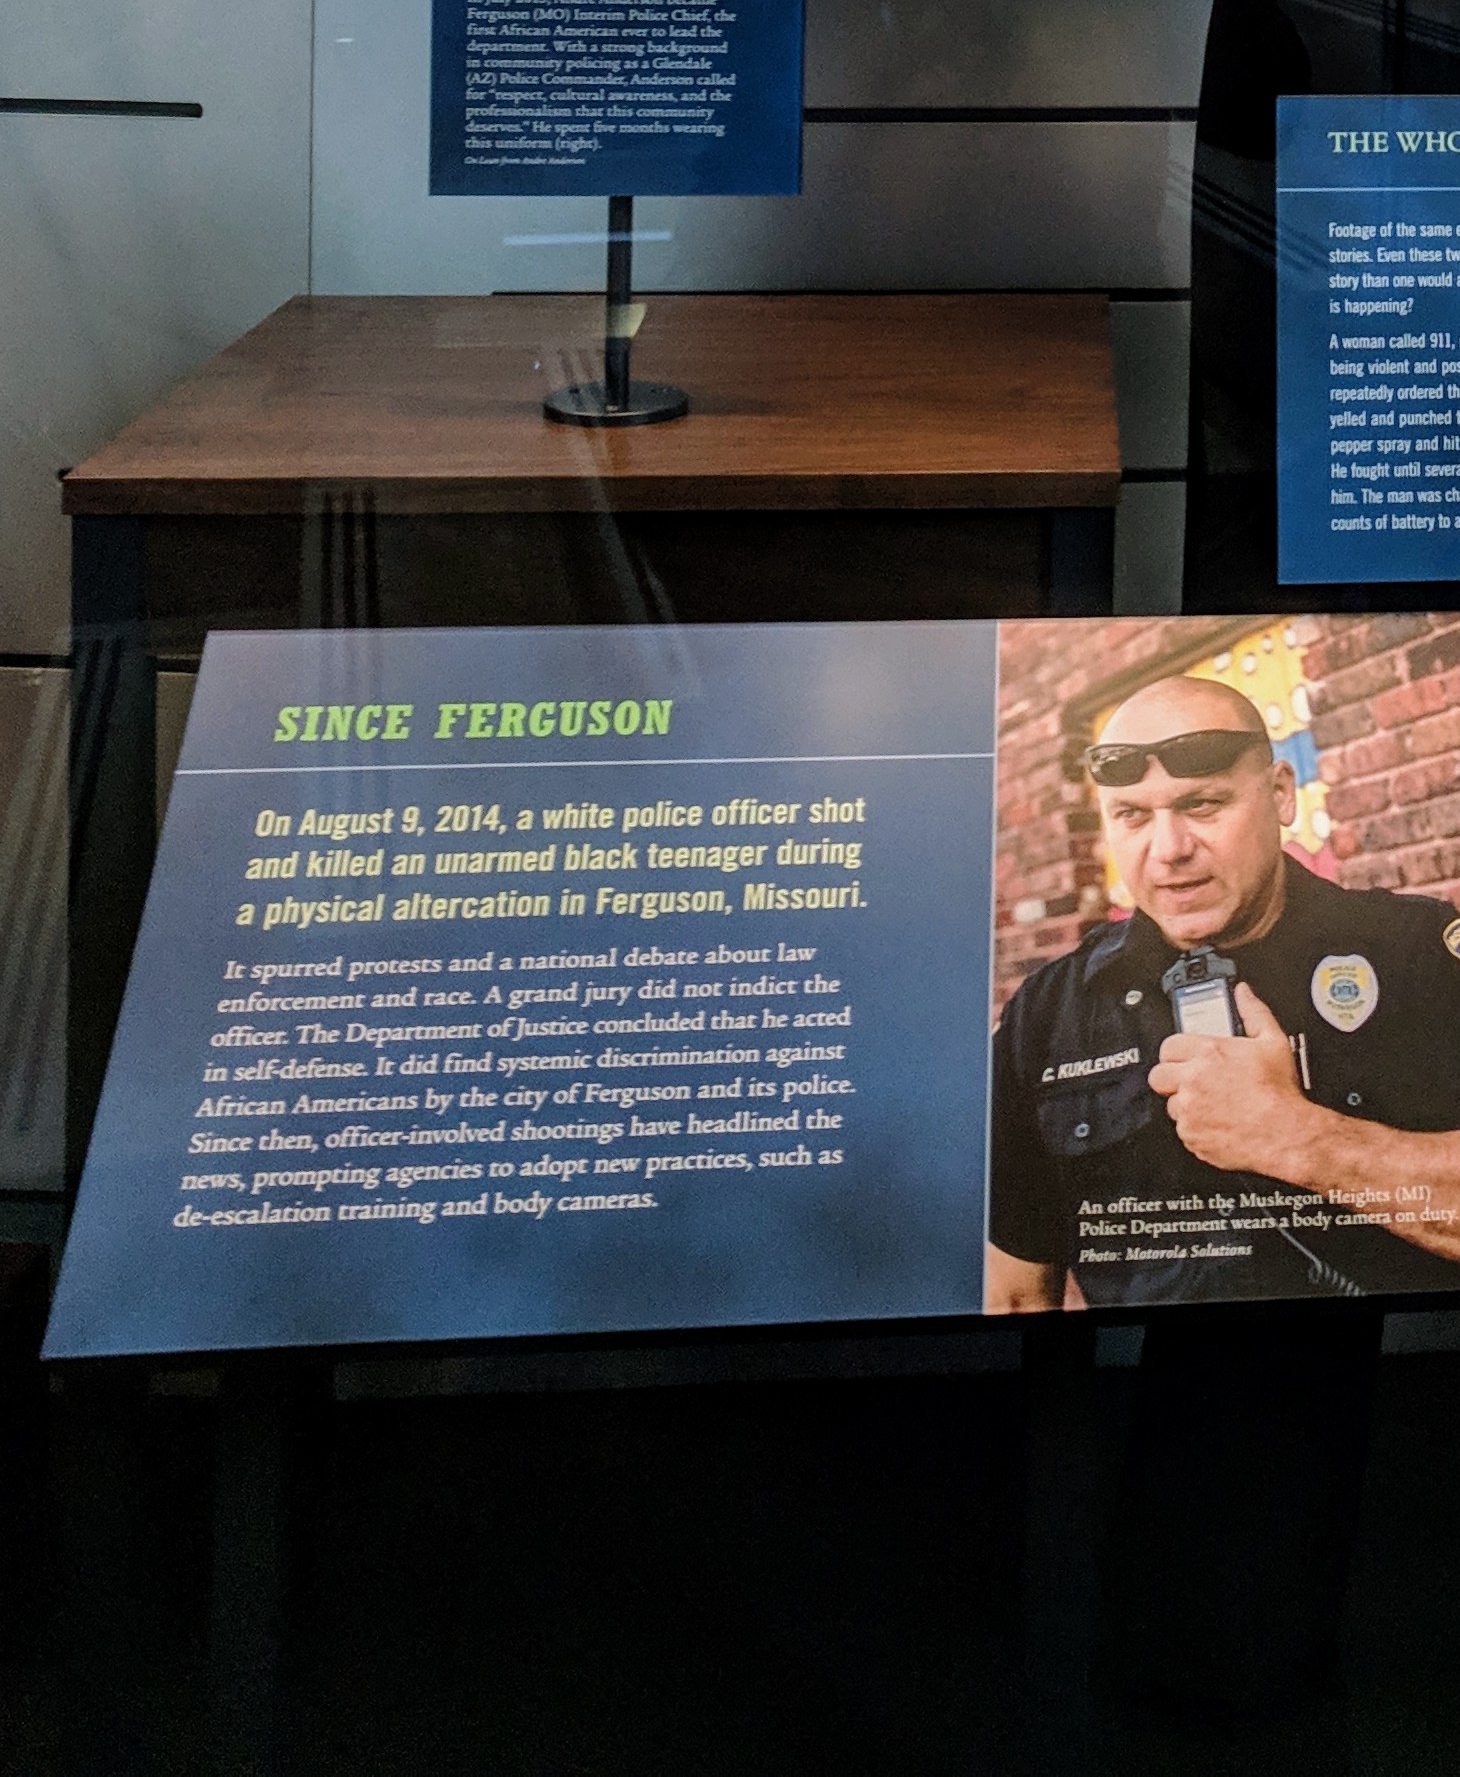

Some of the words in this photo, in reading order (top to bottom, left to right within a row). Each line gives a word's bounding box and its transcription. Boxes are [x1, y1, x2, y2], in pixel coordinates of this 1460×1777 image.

[1327, 131, 1389, 153] THE
[1328, 222, 1377, 241] Footage
[1379, 221, 1393, 238] of
[1396, 222, 1417, 238] the
[1419, 224, 1453, 238] same
[274, 704, 414, 742] SINCE
[433, 699, 673, 739] FERGUSON
[255, 809, 292, 837] On
[297, 808, 395, 841] August
[401, 805, 425, 837] 9,
[434, 804, 507, 835] 2014,
[515, 809, 534, 831] a
[542, 802, 615, 830] white
[621, 800, 704, 834] police
[711, 798, 802, 826] officer
[808, 796, 866, 824] shot
[244, 850, 300, 880] and
[305, 848, 385, 878] killed
[391, 853, 427, 876] an
[434, 844, 557, 875] unarmed
[563, 842, 639, 871] black
[647, 843, 769, 873] teenager
[776, 837, 863, 869] during
[235, 903, 256, 926] a
[262, 893, 386, 931] physical
[392, 889, 551, 921] altercation
[559, 888, 587, 916] in
[595, 886, 733, 920] Ferguson,
[743, 880, 868, 911] Missouri.
[1077, 1200, 1104, 1215] An
[1107, 1196, 1163, 1214] officer
[1165, 1194, 1204, 1211] with
[1208, 1194, 1236, 1210] the
[1239, 1190, 1323, 1211] Muskegon
[1326, 1186, 1390, 1208] Heights
[1395, 1186, 1430, 1201] (MI)
[1079, 1219, 1127, 1236] Police
[1130, 1218, 1228, 1239] Department
[1230, 1218, 1277, 1232] wears
[1280, 1219, 1290, 1228] a
[1292, 1211, 1332, 1231] body
[1335, 1212, 1392, 1225] camera
[1395, 1211, 1416, 1223] on
[1420, 1206, 1459, 1225] duty.
